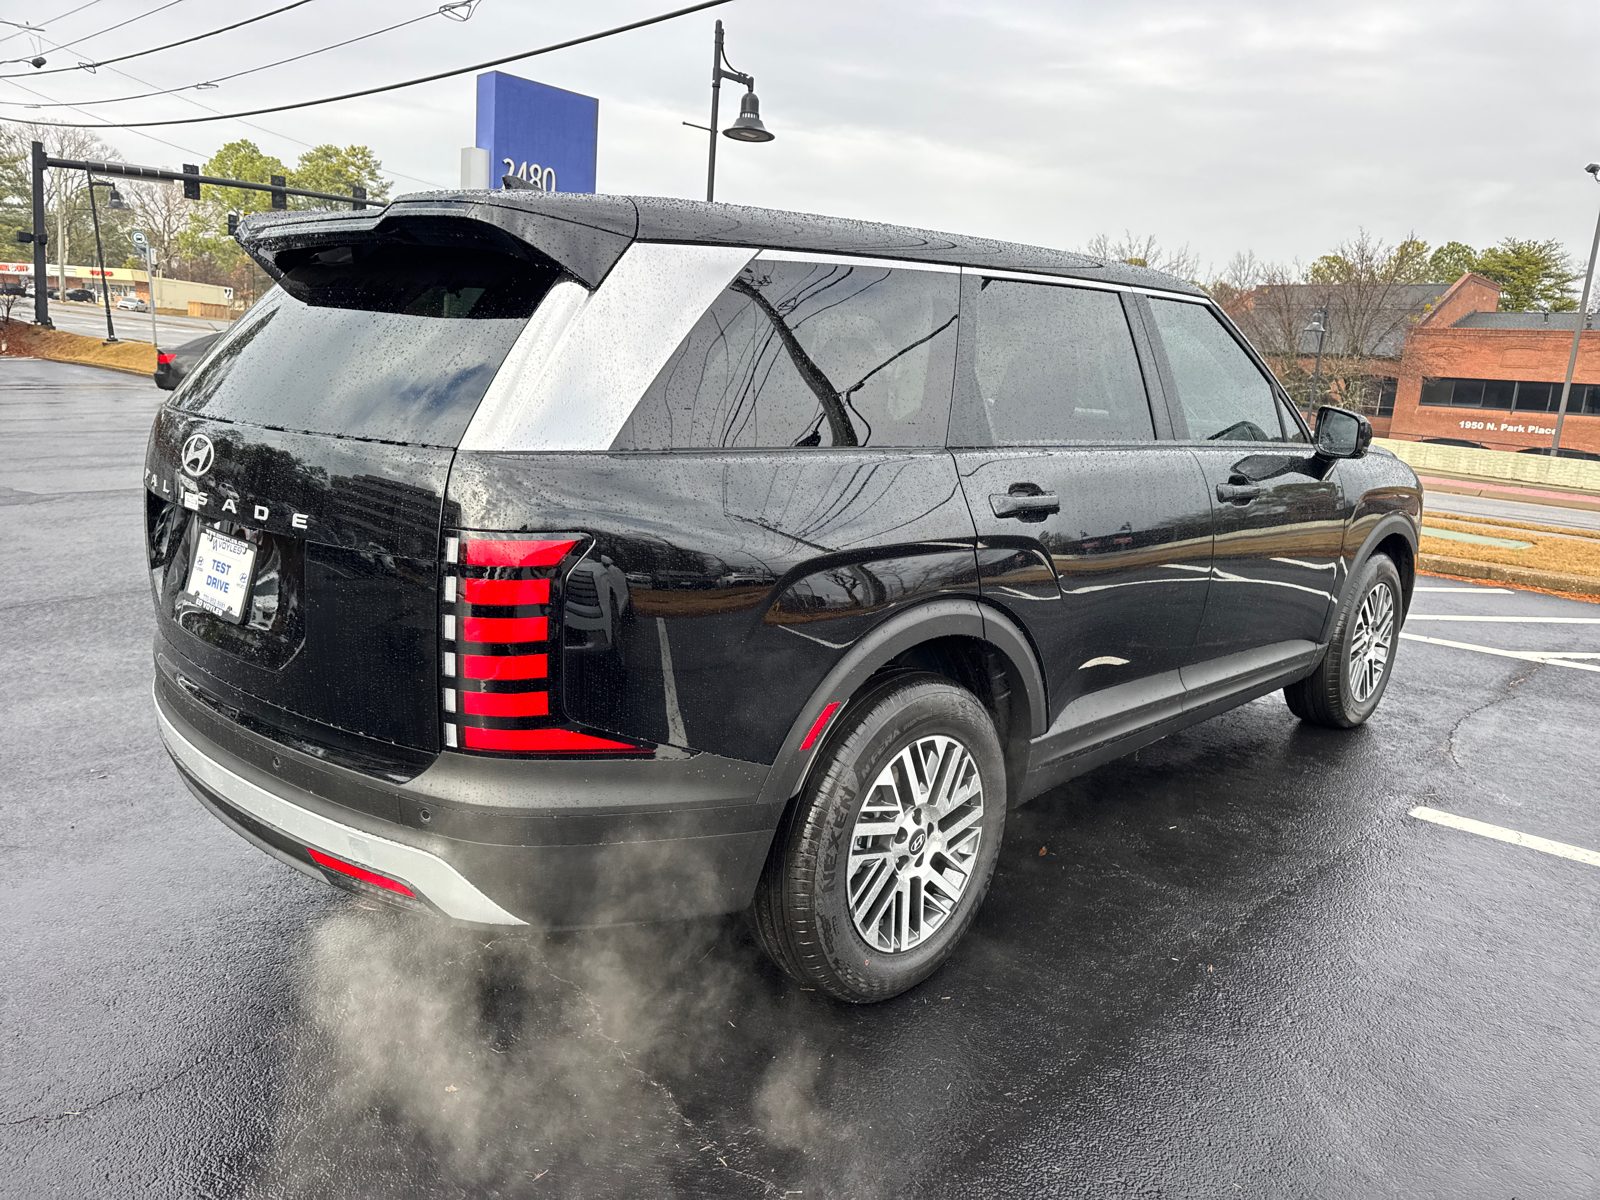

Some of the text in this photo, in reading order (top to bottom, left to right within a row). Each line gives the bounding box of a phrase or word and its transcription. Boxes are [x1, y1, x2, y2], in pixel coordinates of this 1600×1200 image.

[1459, 420, 1556, 435] 1950 N. Park Place
[212, 558, 232, 576] TEST
[206, 575, 230, 594] DRIVE
[822, 785, 857, 894] NEXEN
